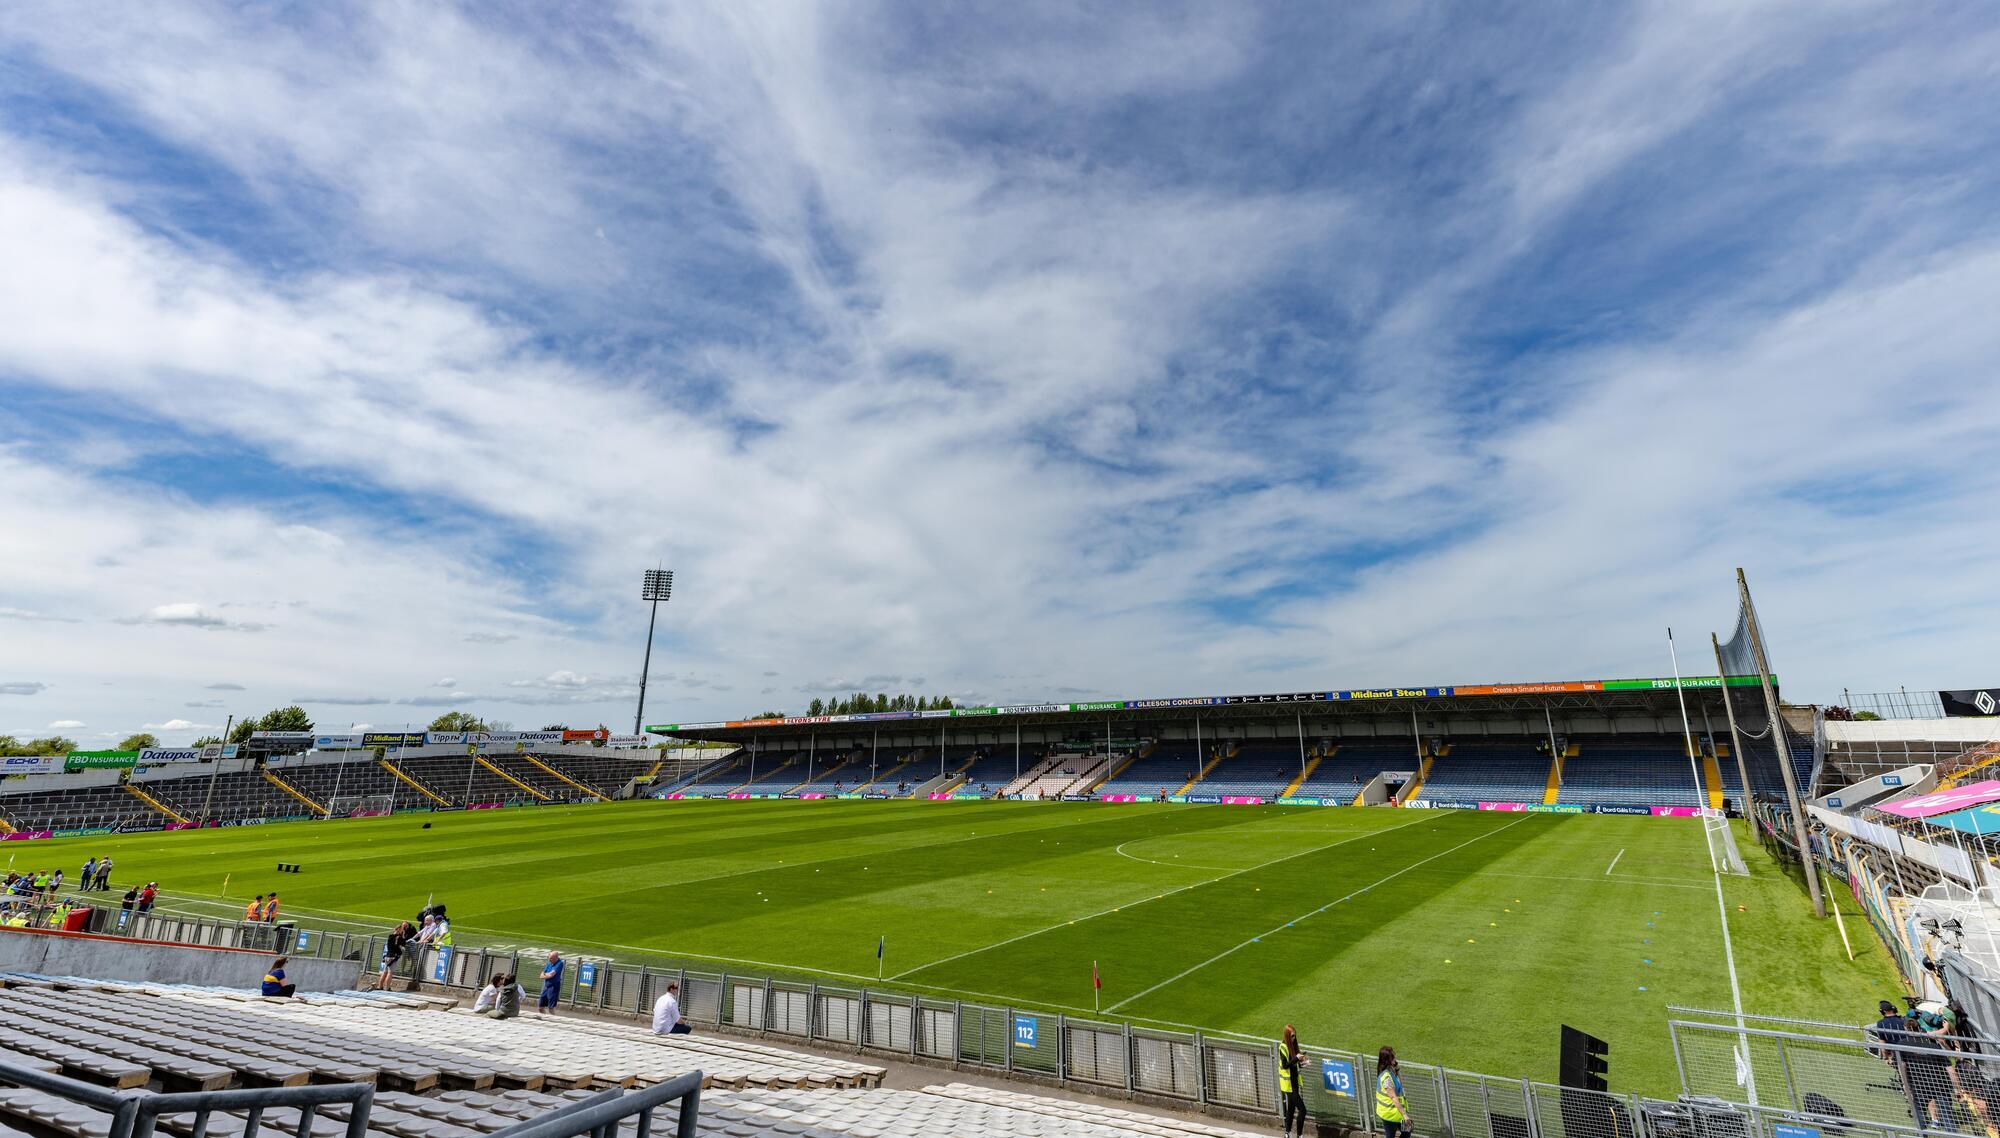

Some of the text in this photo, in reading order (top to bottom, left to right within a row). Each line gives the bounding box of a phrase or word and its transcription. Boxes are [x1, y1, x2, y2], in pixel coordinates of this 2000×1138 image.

[1351, 689, 1427, 699] Midland Steel
[1137, 700, 1171, 708] GLEESON
[433, 733, 450, 743] Tipp
[519, 732, 561, 741] Datapac
[69, 756, 135, 764] FBD INSURANCE
[141, 750, 199, 761] Datapac
[1555, 805, 1582, 813] Centra
[1660, 807, 1674, 816] eir
[1017, 1026, 1033, 1040] 112
[1327, 1070, 1350, 1089] 113
